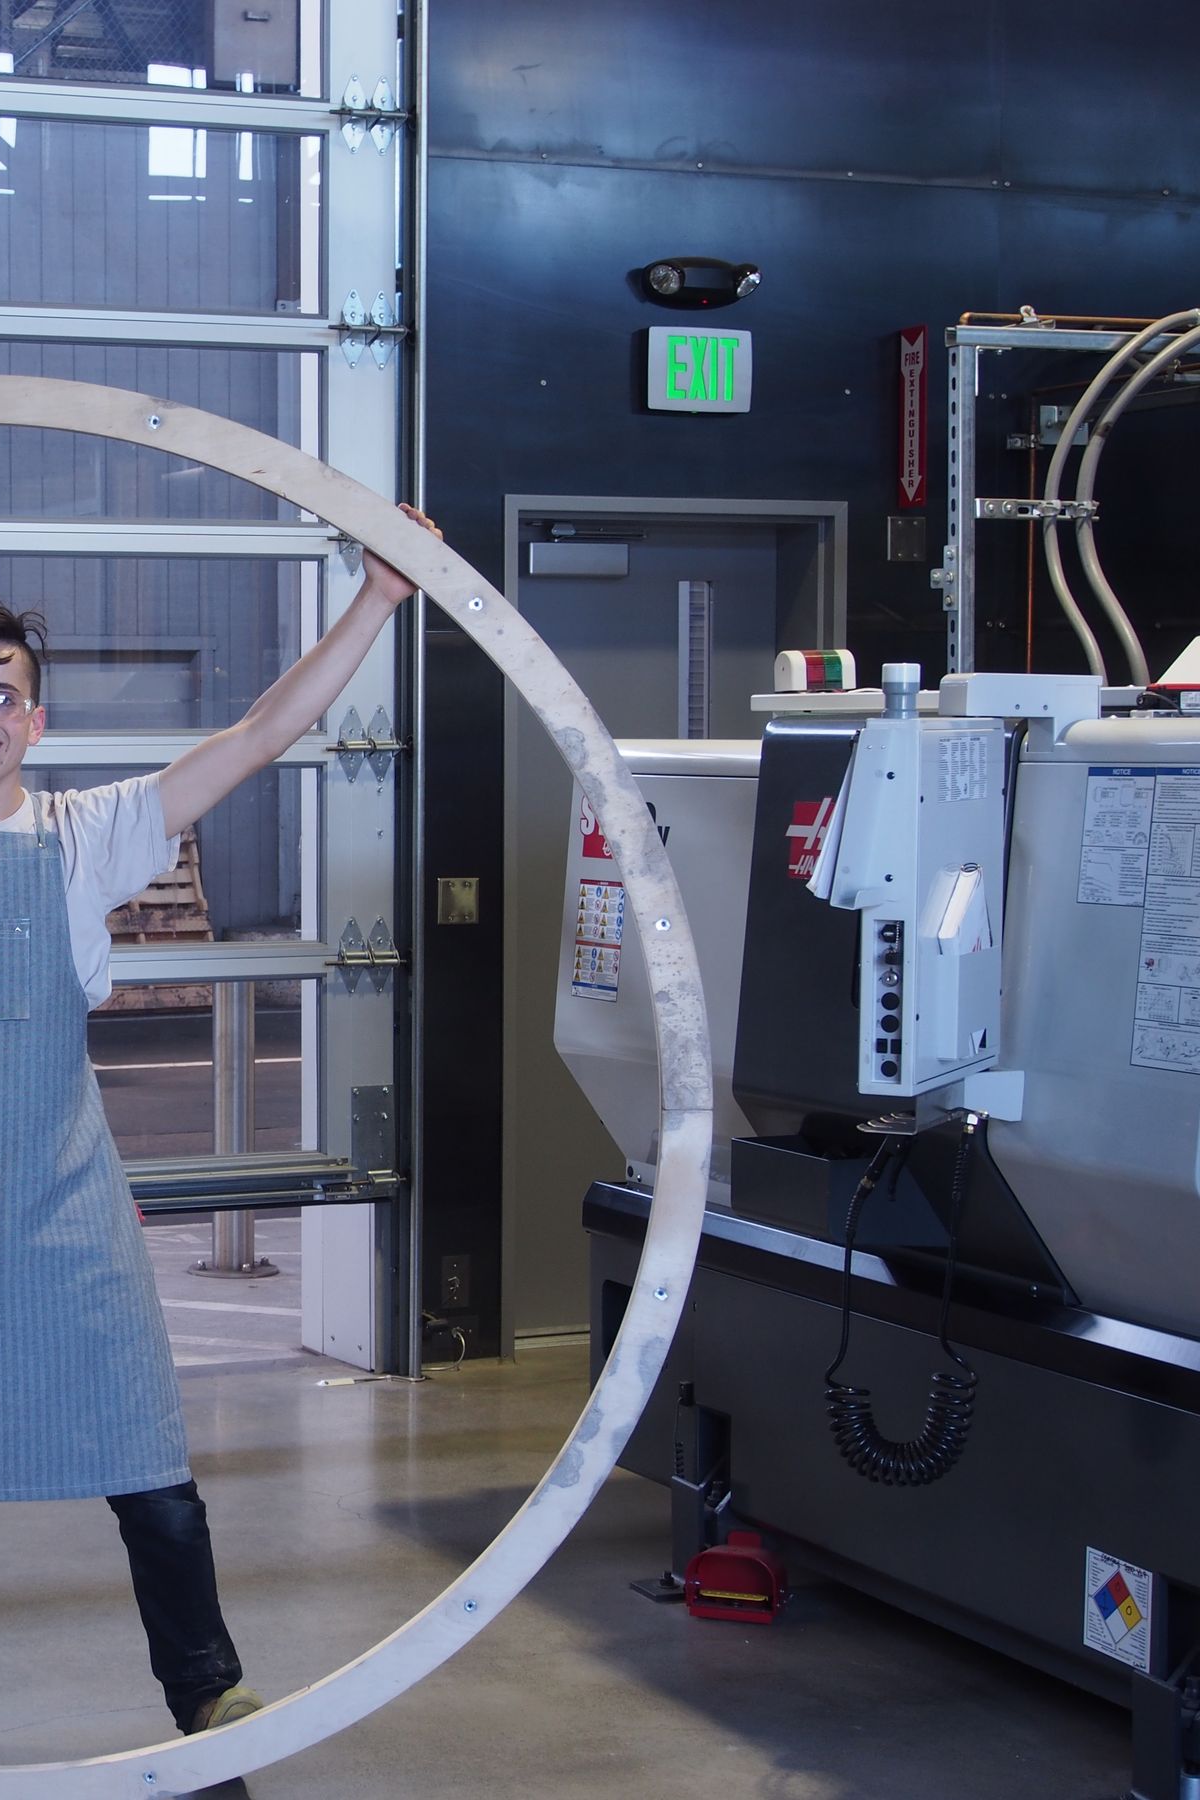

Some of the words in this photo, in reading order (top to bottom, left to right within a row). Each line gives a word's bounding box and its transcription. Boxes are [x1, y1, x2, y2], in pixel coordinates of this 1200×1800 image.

[667, 335, 739, 401] EXIT
[904, 351, 920, 367] FIRE
[908, 369, 916, 488] EXTINGUISHER
